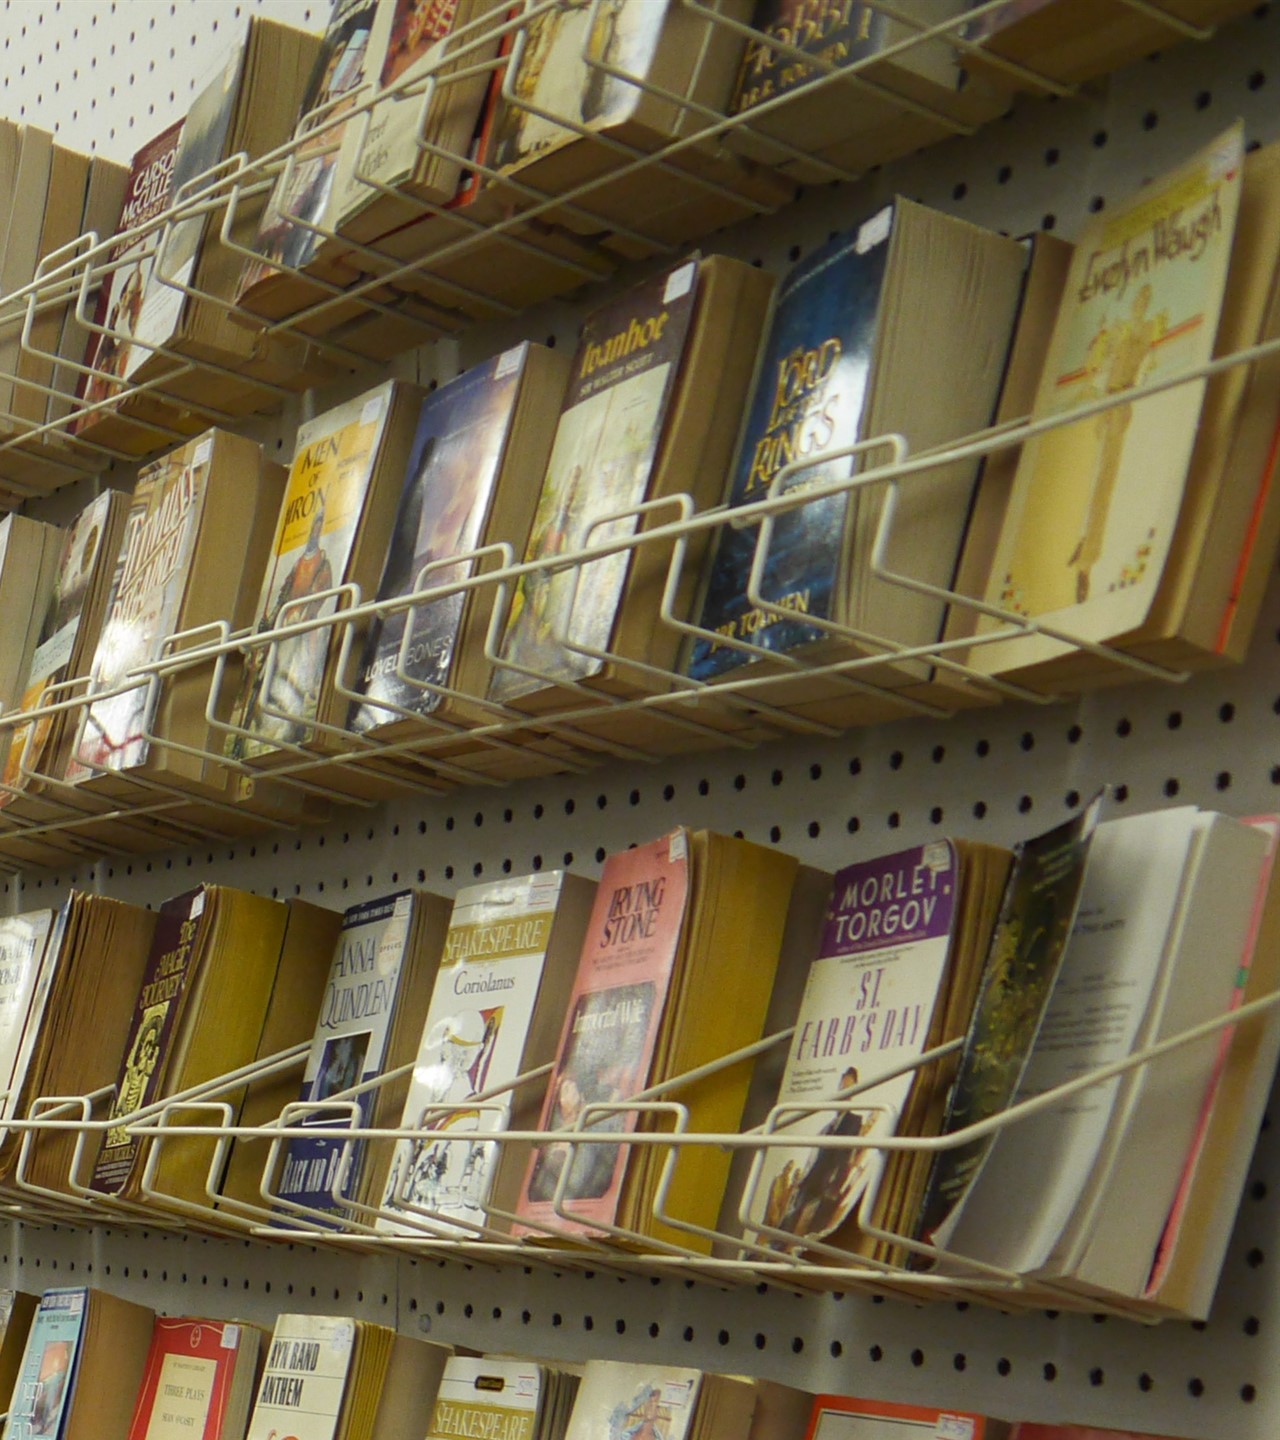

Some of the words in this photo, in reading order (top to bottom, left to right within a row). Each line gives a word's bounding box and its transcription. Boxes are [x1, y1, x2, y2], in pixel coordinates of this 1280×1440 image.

[301, 437, 339, 475] MEN
[609, 876, 668, 919] IRVING
[840, 862, 942, 911] MORLEY
[599, 910, 659, 949] STONE
[835, 893, 938, 944] TORGOV
[333, 935, 377, 978] ANNA
[441, 916, 545, 965] SHAKESPEARE
[320, 975, 395, 1029] QUINDLEN
[453, 970, 516, 997] Coriolanus
[856, 967, 886, 1011] ST.
[879, 1004, 921, 1050] DAY
[268, 1339, 289, 1369] AYN
[289, 1341, 321, 1371] RAND
[260, 1373, 304, 1408] ANTHEM
